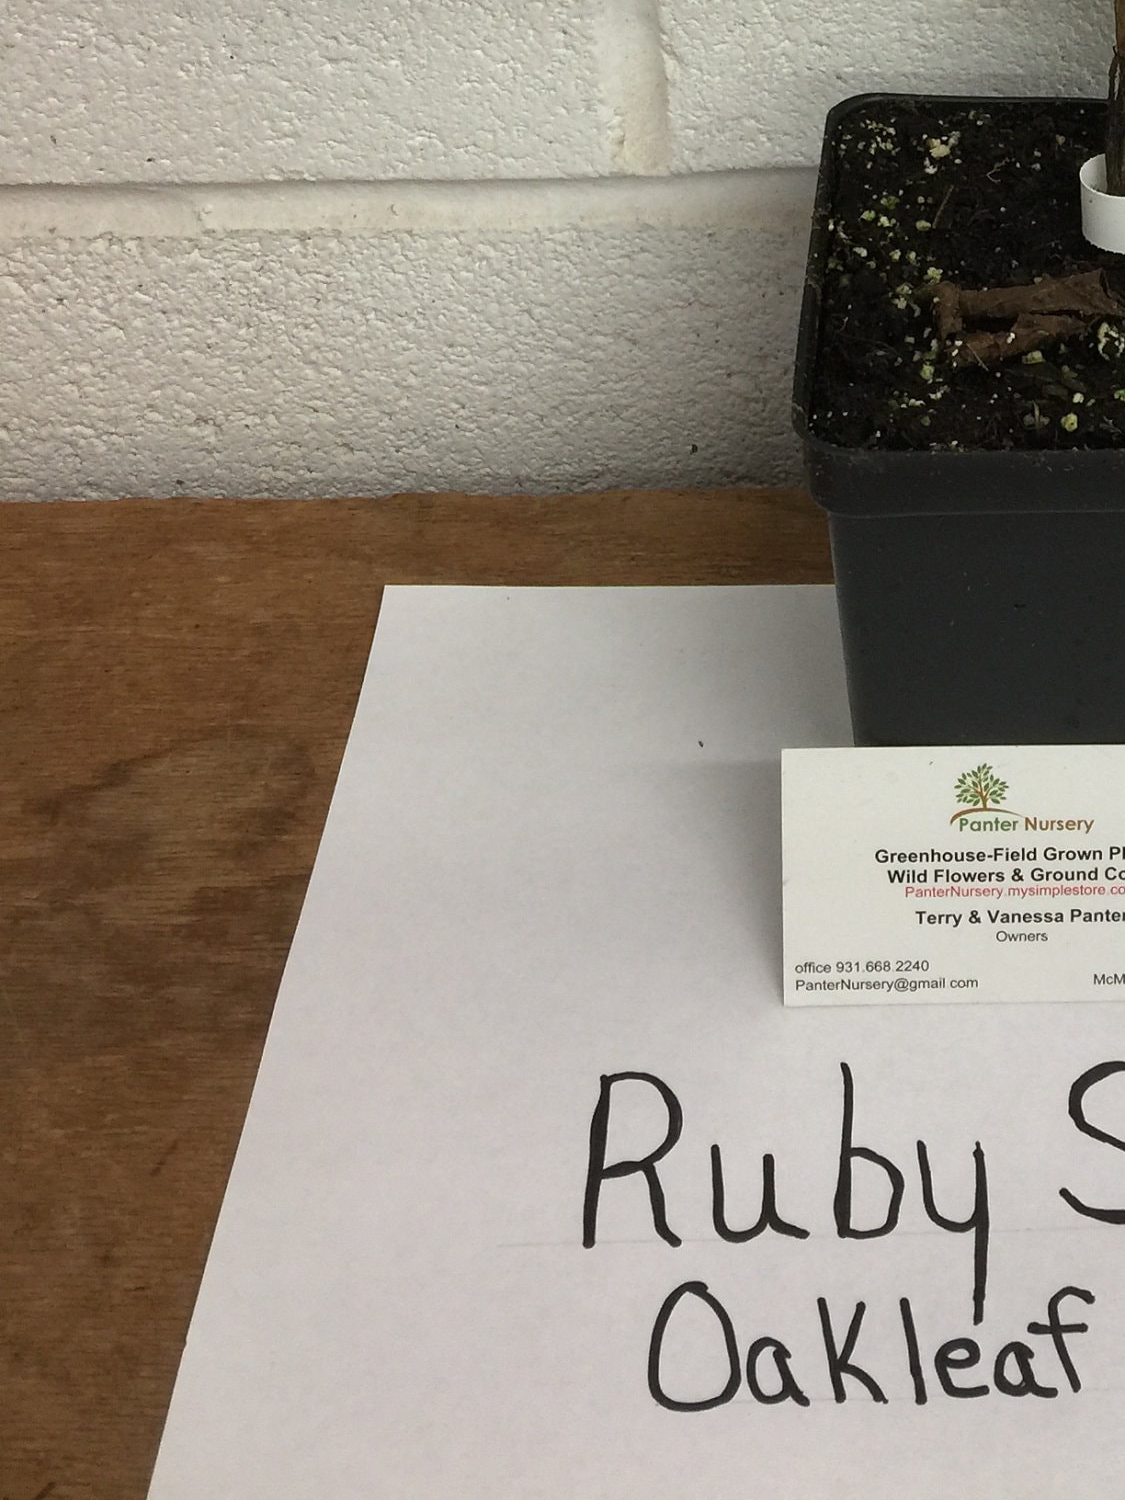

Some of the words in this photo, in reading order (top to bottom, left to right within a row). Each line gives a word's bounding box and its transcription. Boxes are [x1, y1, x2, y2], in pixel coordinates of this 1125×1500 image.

[959, 817, 1019, 832] Panter
[1024, 816, 1095, 835] Nursery
[874, 847, 1038, 863] Greenhouse-Field
[1043, 846, 1104, 862] Grown
[887, 869, 928, 884] Wild
[933, 868, 1006, 883] Flowers
[1011, 867, 1025, 882] &
[1030, 867, 1099, 882] Ground
[915, 910, 963, 928] Terry
[968, 909, 982, 925] &
[986, 909, 1065, 924] Vanessa
[995, 930, 1049, 943] Owners
[794, 961, 832, 974] office
[835, 960, 930, 973] 931.668.2240
[582, 1062, 990, 1326] Ruby
[647, 1280, 1096, 1413] Oakleaf
